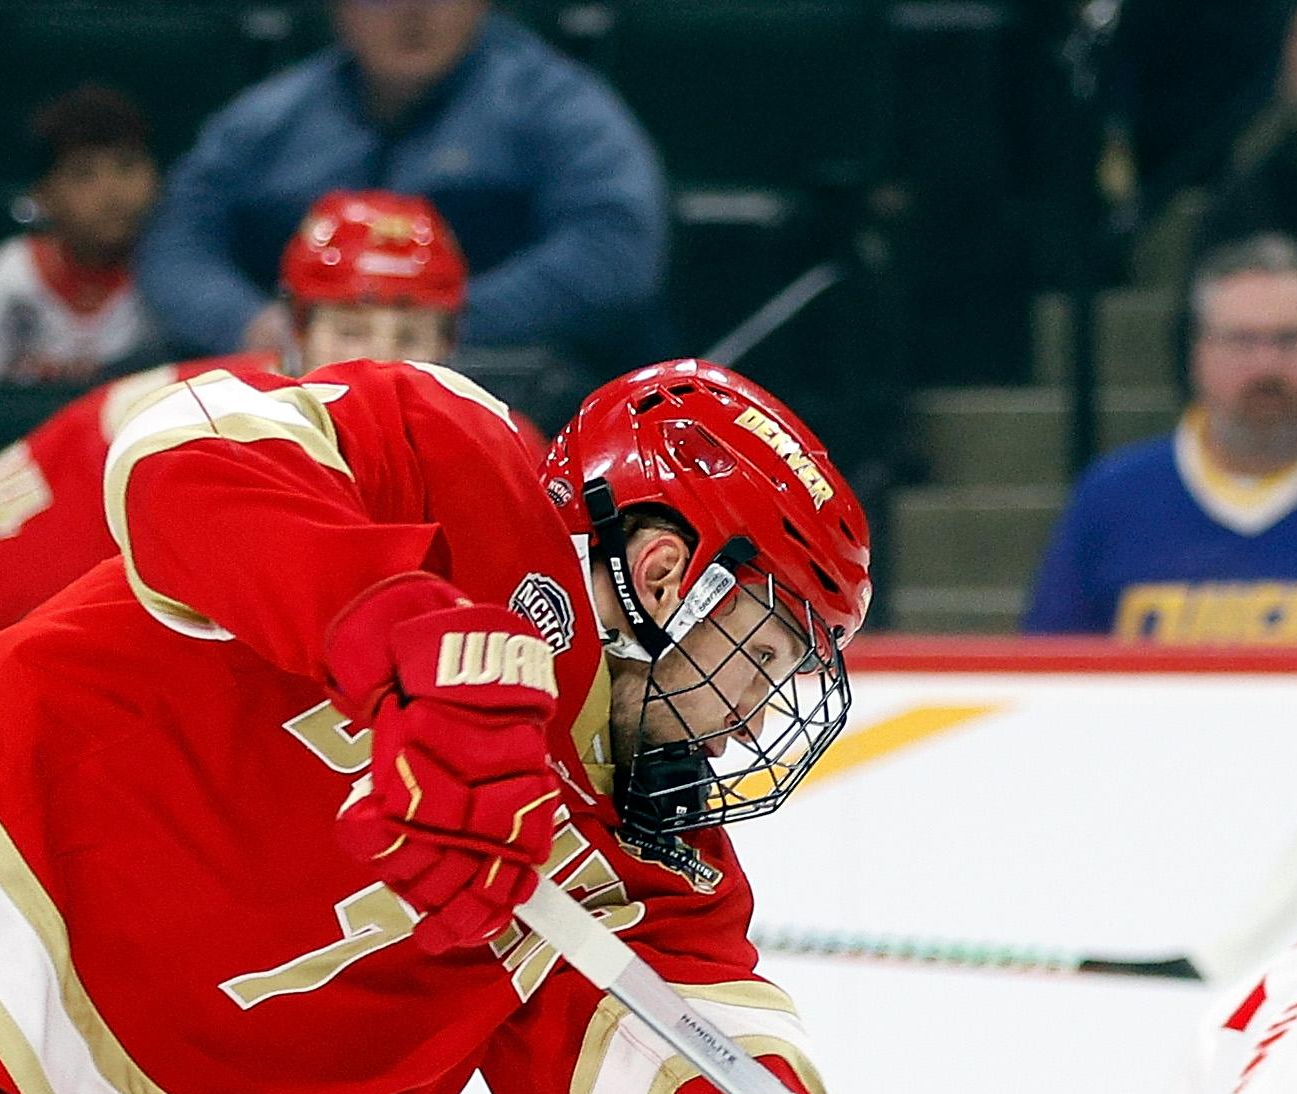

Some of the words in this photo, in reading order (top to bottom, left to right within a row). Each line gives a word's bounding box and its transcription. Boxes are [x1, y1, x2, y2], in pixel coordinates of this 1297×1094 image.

[734, 406, 833, 510] DENVER
[517, 581, 566, 653] NCHC
[217, 880, 429, 1011] 7
